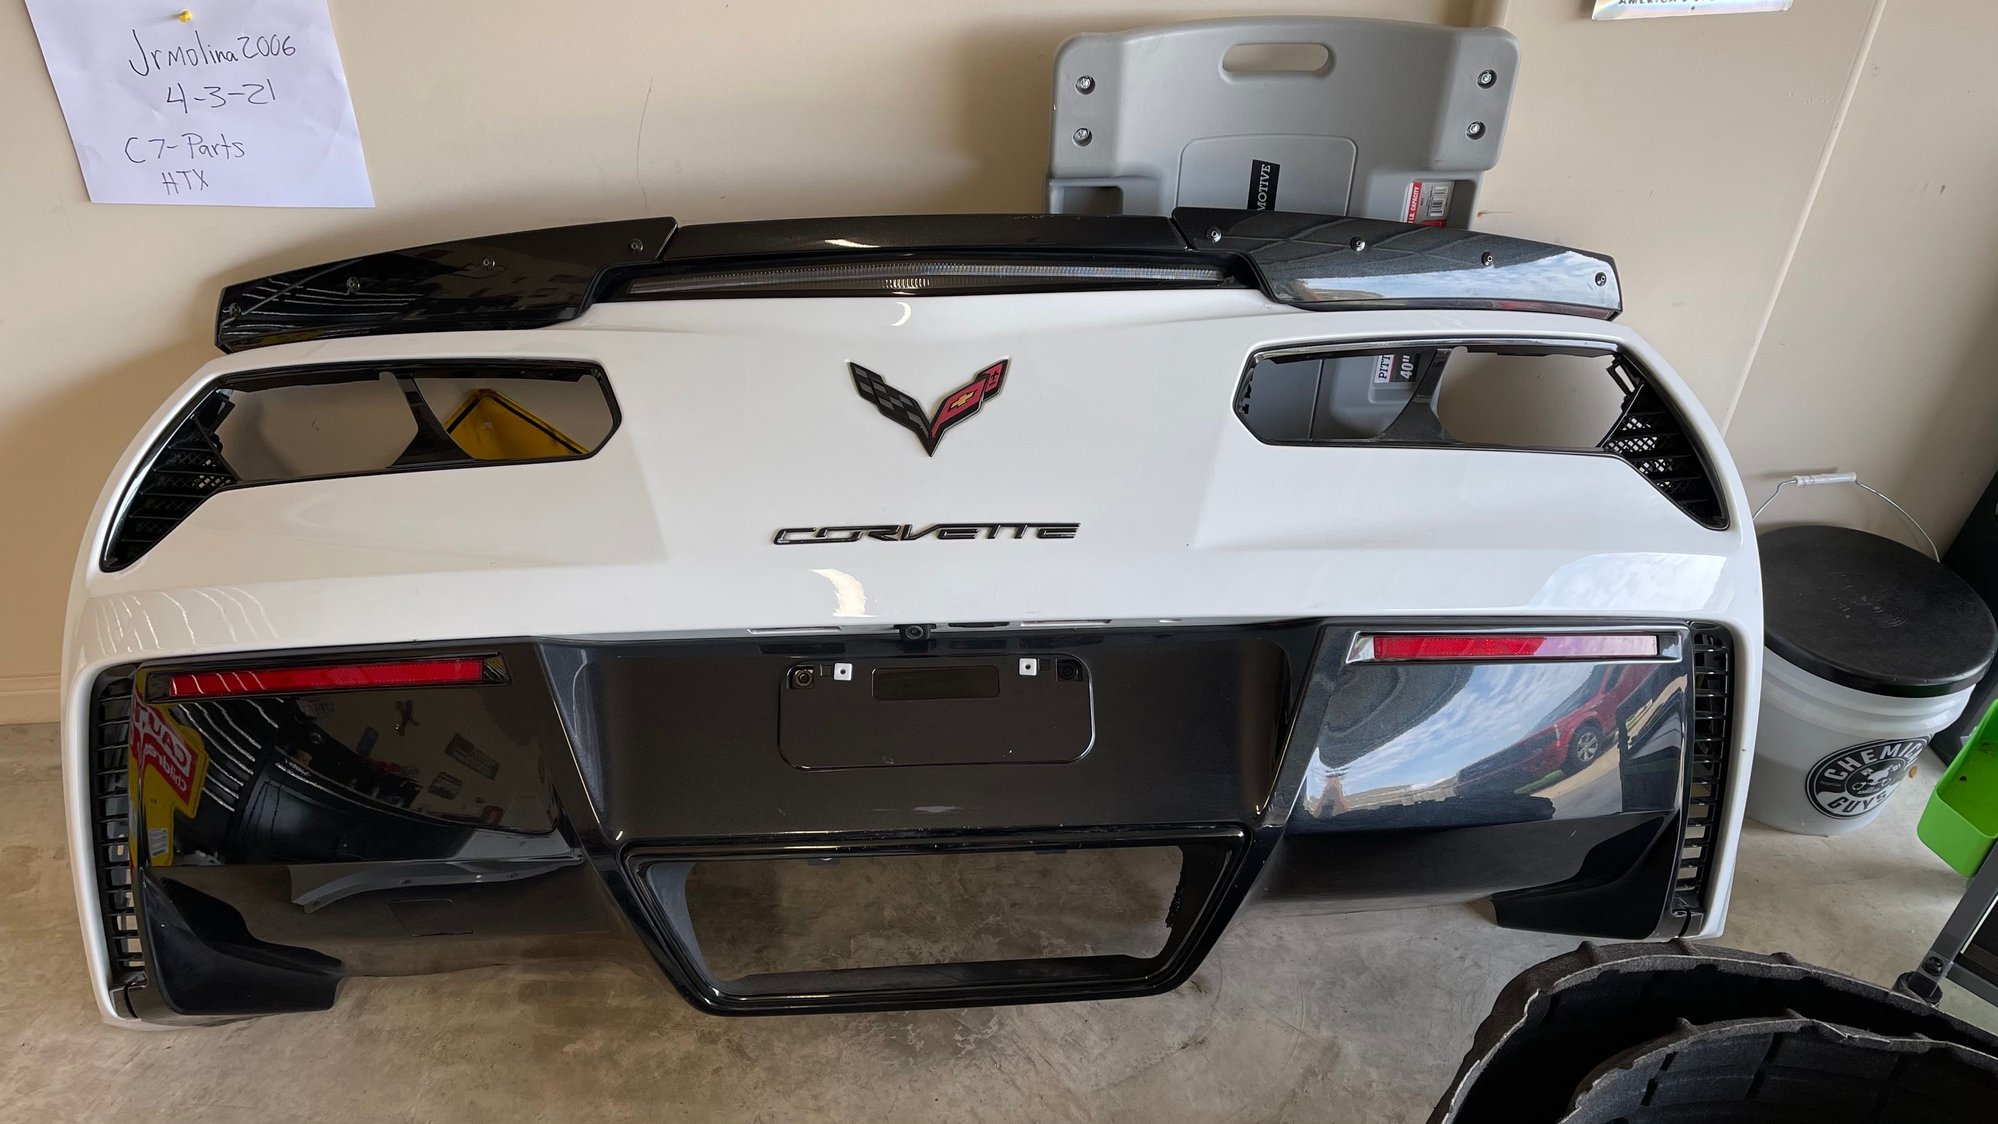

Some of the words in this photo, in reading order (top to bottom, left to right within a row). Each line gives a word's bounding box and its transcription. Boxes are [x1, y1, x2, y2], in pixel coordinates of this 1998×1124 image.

[166, 79, 276, 114] 4-3-21
[162, 169, 209, 196] HTX
[1410, 186, 1420, 212] CAPACITY
[1400, 354, 1414, 380] 40"
[773, 522, 1081, 545] CORVETTE
[1827, 790, 1887, 813] GUYS
